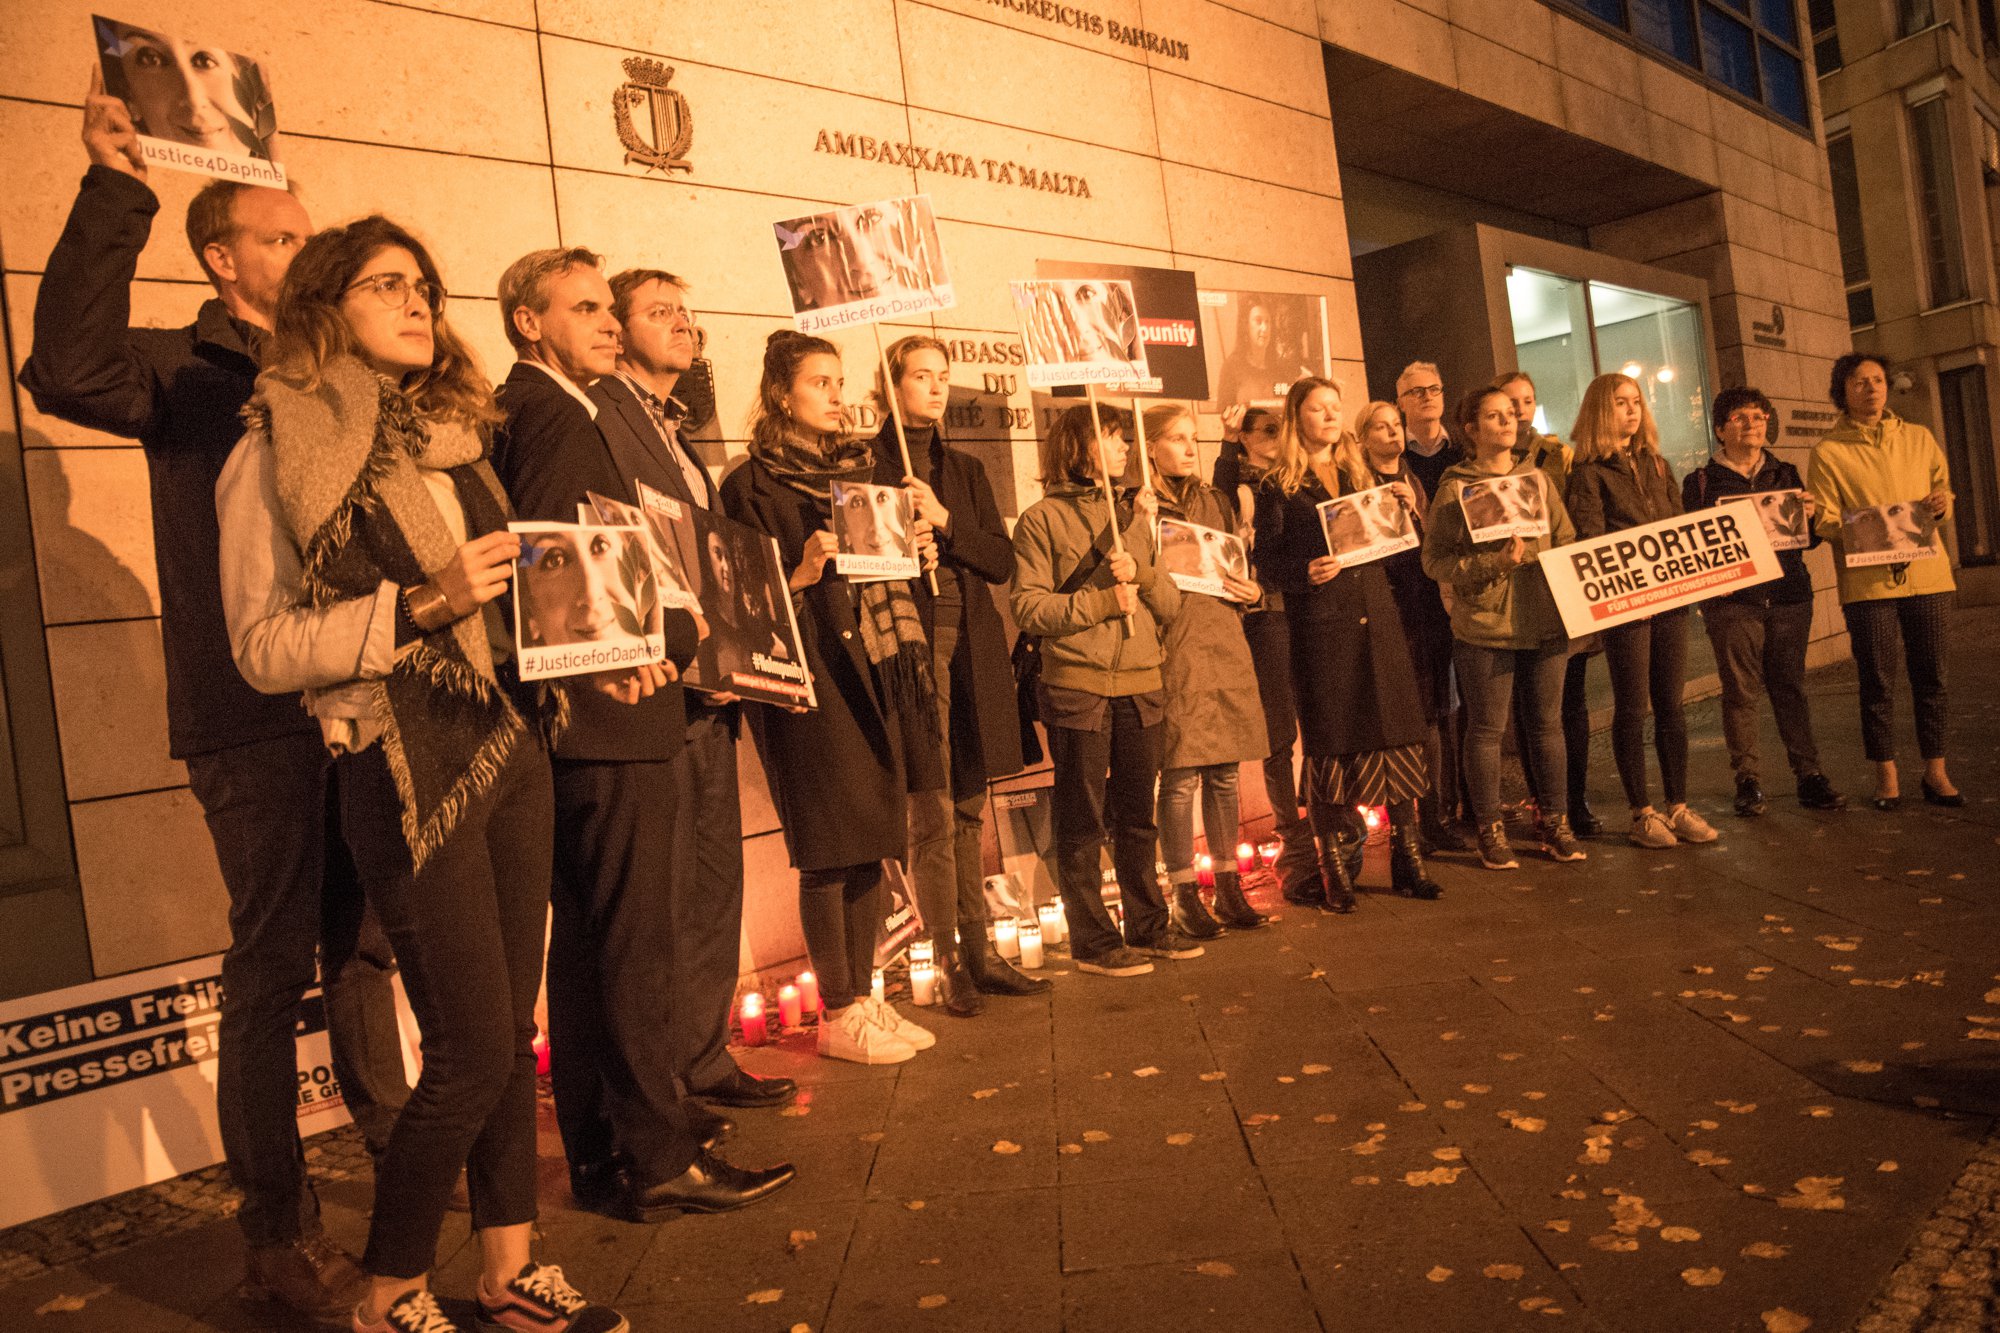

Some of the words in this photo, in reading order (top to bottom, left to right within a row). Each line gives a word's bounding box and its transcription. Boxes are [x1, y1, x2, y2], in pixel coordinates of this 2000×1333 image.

[1107, 20, 1190, 61] BAHRAIN
[138, 141, 283, 182] Justice4Daphne
[814, 128, 980, 179] AMBAXXATA
[1018, 165, 1093, 199] MALTA
[1139, 323, 1196, 347] punity
[982, 372, 1017, 397] DU
[1570, 514, 1742, 582] REPORTER
[1583, 569, 1648, 602] OHNE
[1652, 541, 1750, 583] GRENZEN
[1606, 600, 1630, 614] FÜR
[1631, 567, 1742, 607] INFORMATIONSFREIHEIT
[526, 645, 661, 673] #JusticeforDaphne
[0, 1010, 122, 1057] Keine
[130, 981, 224, 1026] Freih
[1, 1024, 220, 1105] Pressefrei
